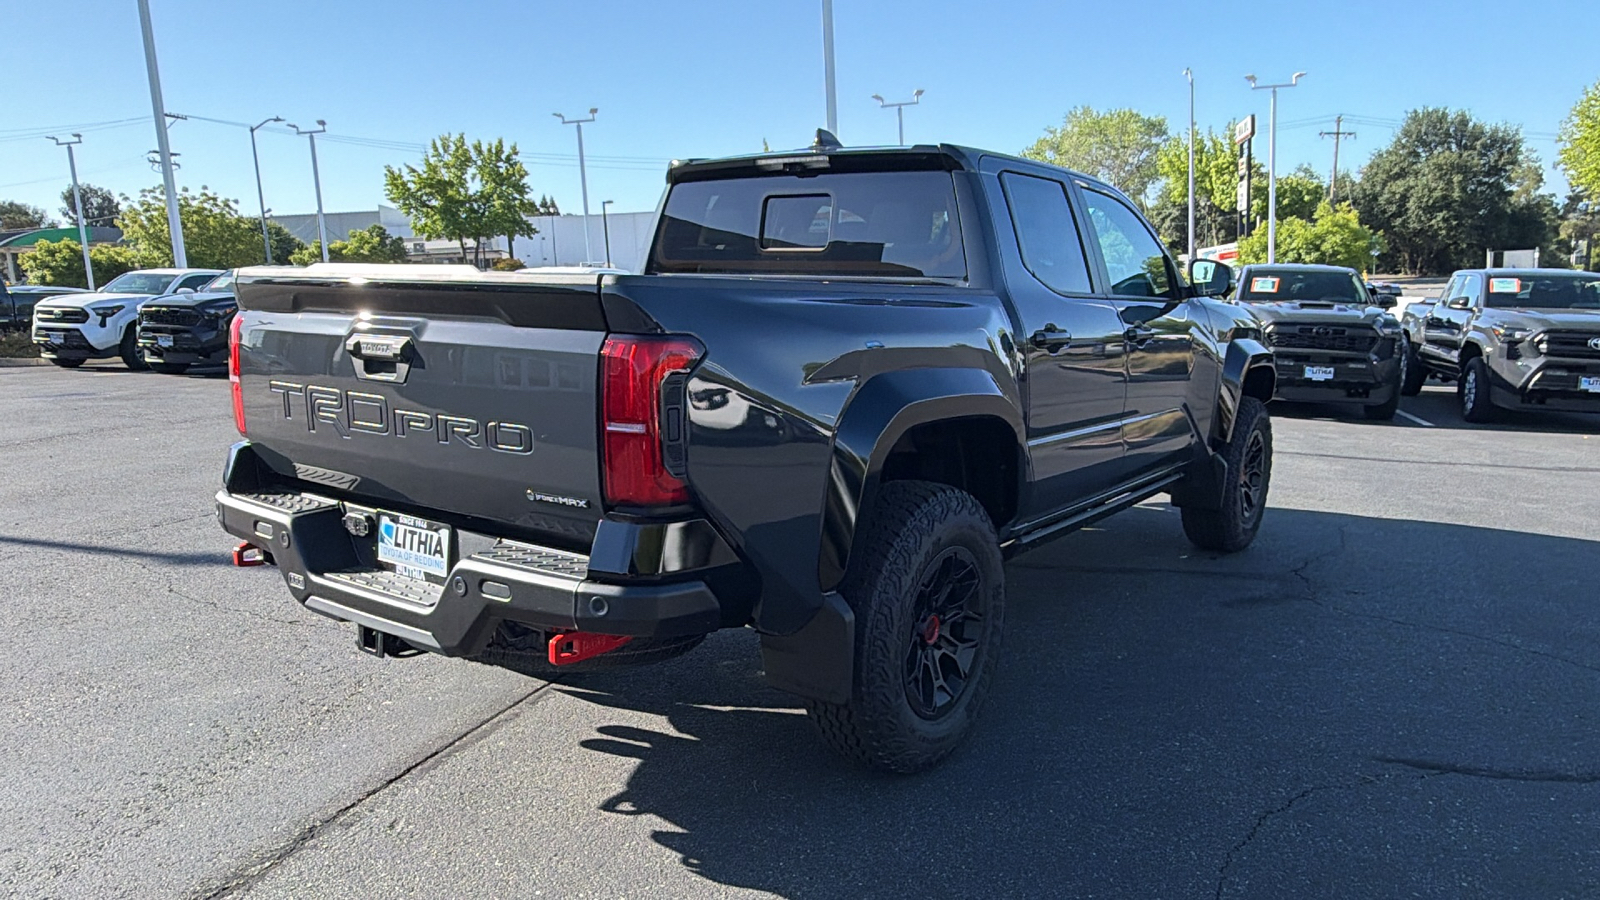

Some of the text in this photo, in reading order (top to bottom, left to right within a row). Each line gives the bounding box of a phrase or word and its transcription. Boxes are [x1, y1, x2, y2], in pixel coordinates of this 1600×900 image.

[361, 343, 391, 354] TOYOTA
[269, 380, 535, 455] TRD PRO
[398, 516, 414, 526] SINCE
[394, 526, 444, 559] LITHIA
[380, 545, 445, 570] TOYOTA OF REDDING
